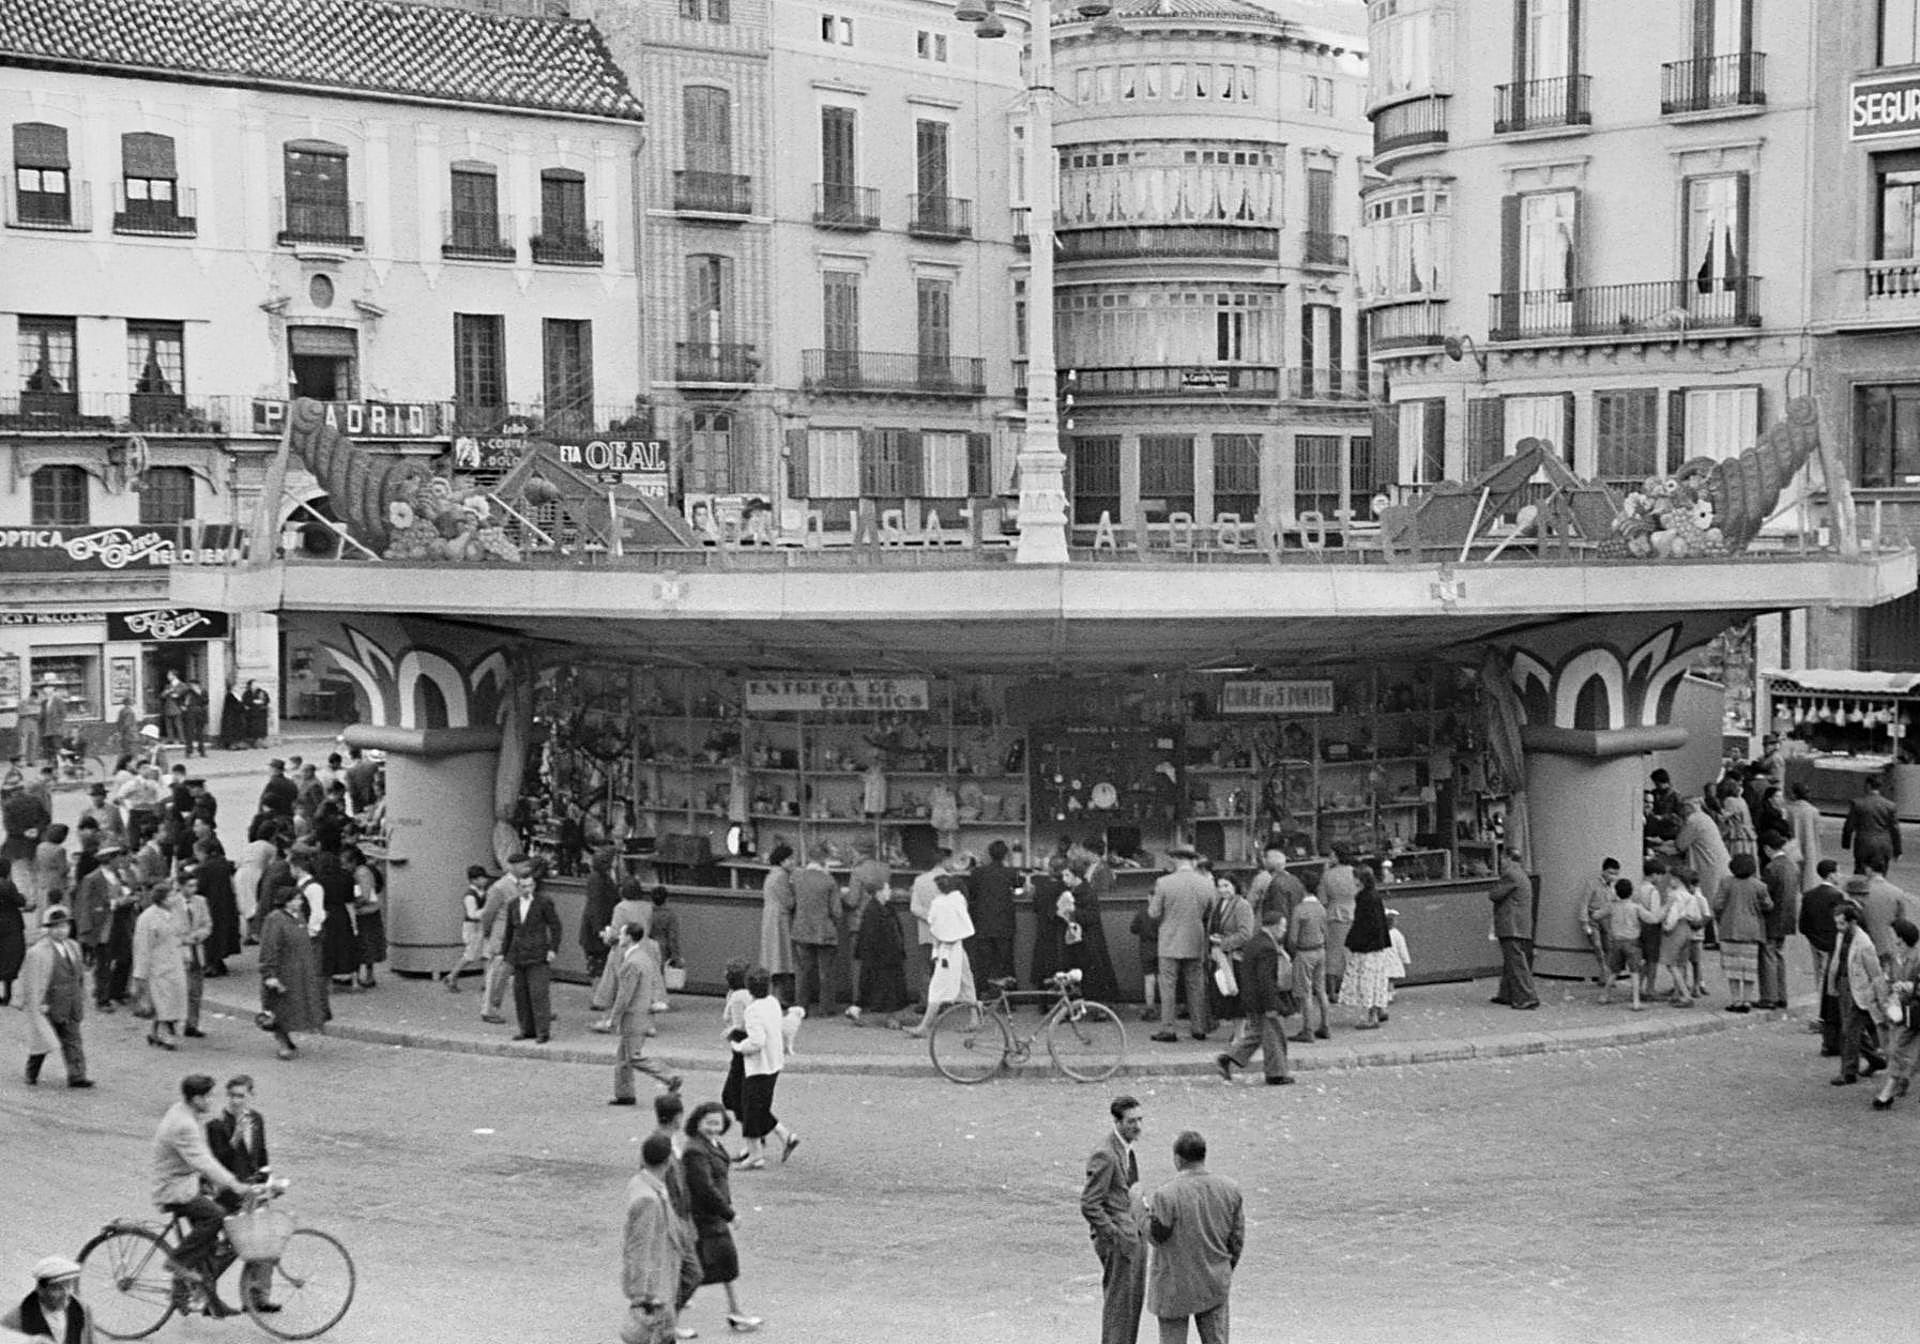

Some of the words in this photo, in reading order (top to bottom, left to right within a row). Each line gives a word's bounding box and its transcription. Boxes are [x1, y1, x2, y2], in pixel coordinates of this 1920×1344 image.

[1853, 88, 1920, 128] SEGUR
[488, 455, 521, 467] DOLO
[585, 440, 666, 470] OKAL
[749, 681, 857, 695] ENTREGA
[868, 681, 896, 695] DE
[820, 695, 923, 709] PREMIOS
